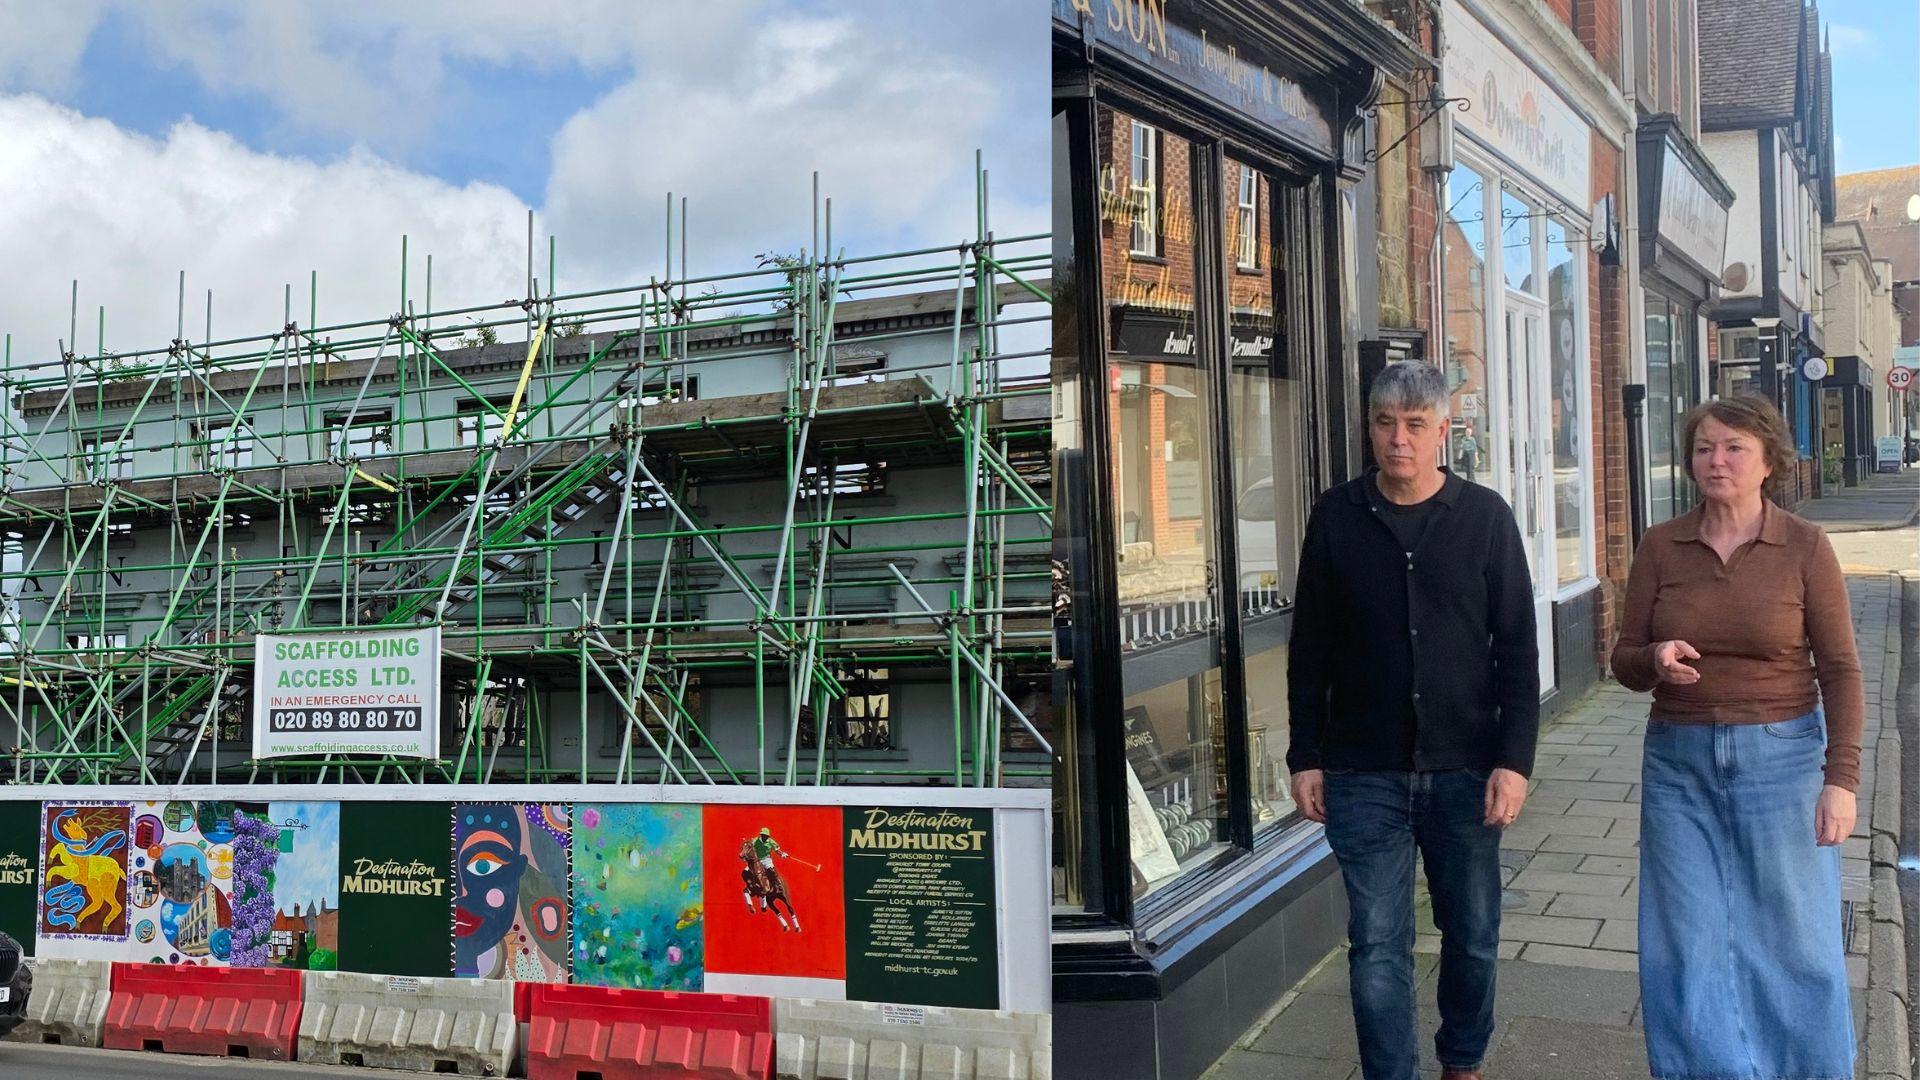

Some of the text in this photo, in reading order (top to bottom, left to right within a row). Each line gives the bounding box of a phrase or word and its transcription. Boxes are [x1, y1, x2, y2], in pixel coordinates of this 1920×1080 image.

[1199, 29, 1307, 122] Jewellery & Gifts
[1891, 372, 1909, 383] 30
[275, 637, 420, 661] SCAFFOLDING
[277, 666, 416, 688] ACCESS LTD.
[271, 694, 421, 706] IN AN EMERGENCY CALL
[274, 710, 416, 729] 020 89 80 80 70
[270, 742, 420, 753] www.scaffoldingaccess.co.uk
[1125, 731, 1154, 751] NGINES
[864, 807, 974, 831] Destination
[849, 829, 987, 851] MIDHURST
[889, 852, 933, 860] SPONSORED
[353, 857, 436, 879] Destination
[342, 875, 446, 896] MIDHURST
[889, 898, 915, 906] LOCAL
[884, 963, 959, 977] midhurst-tc.gov.uk
